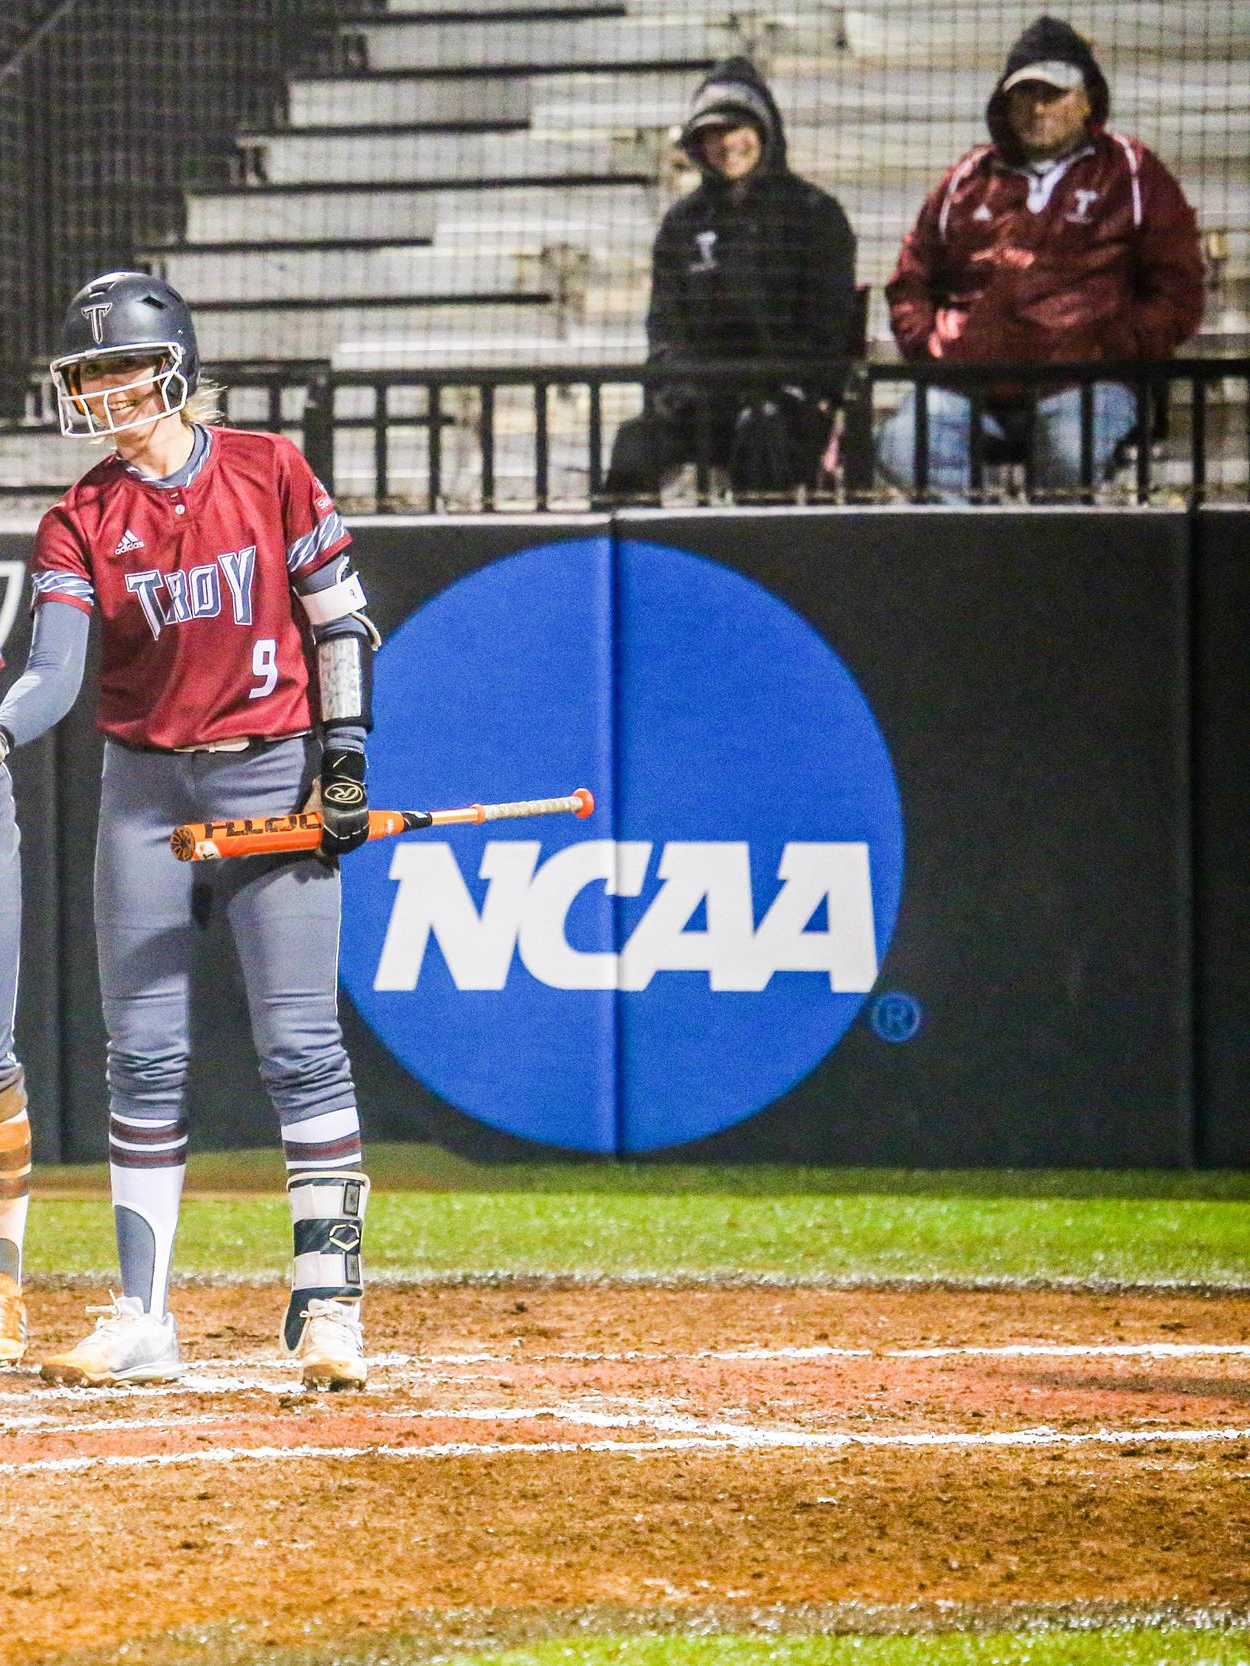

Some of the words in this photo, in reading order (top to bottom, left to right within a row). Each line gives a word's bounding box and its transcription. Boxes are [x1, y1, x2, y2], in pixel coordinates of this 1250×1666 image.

[115, 540, 145, 555] adidas
[125, 545, 257, 641] TROY
[249, 638, 279, 699] 9
[373, 840, 879, 993] NCAA
